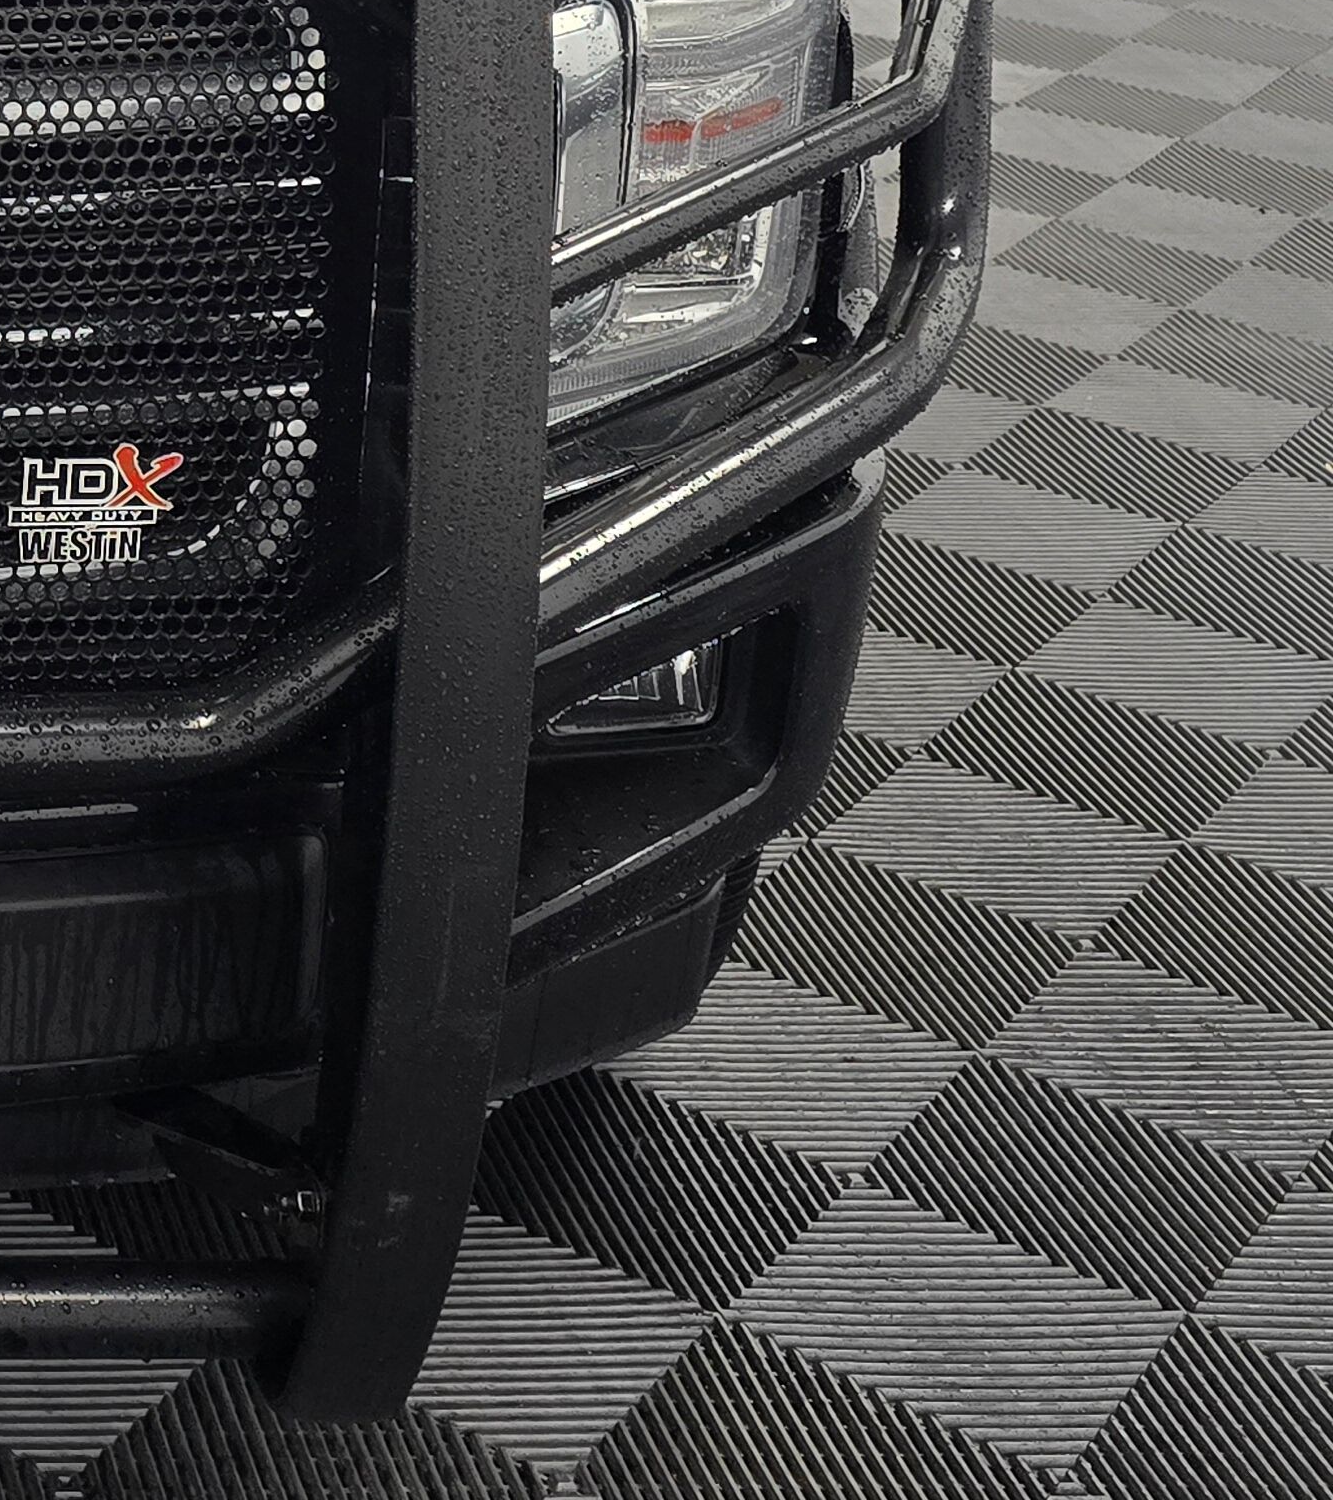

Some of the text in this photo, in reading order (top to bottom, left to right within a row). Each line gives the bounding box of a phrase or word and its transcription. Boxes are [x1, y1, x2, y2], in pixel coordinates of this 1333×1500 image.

[21, 443, 184, 511] HDX
[21, 510, 142, 522] HEAVY DUTY
